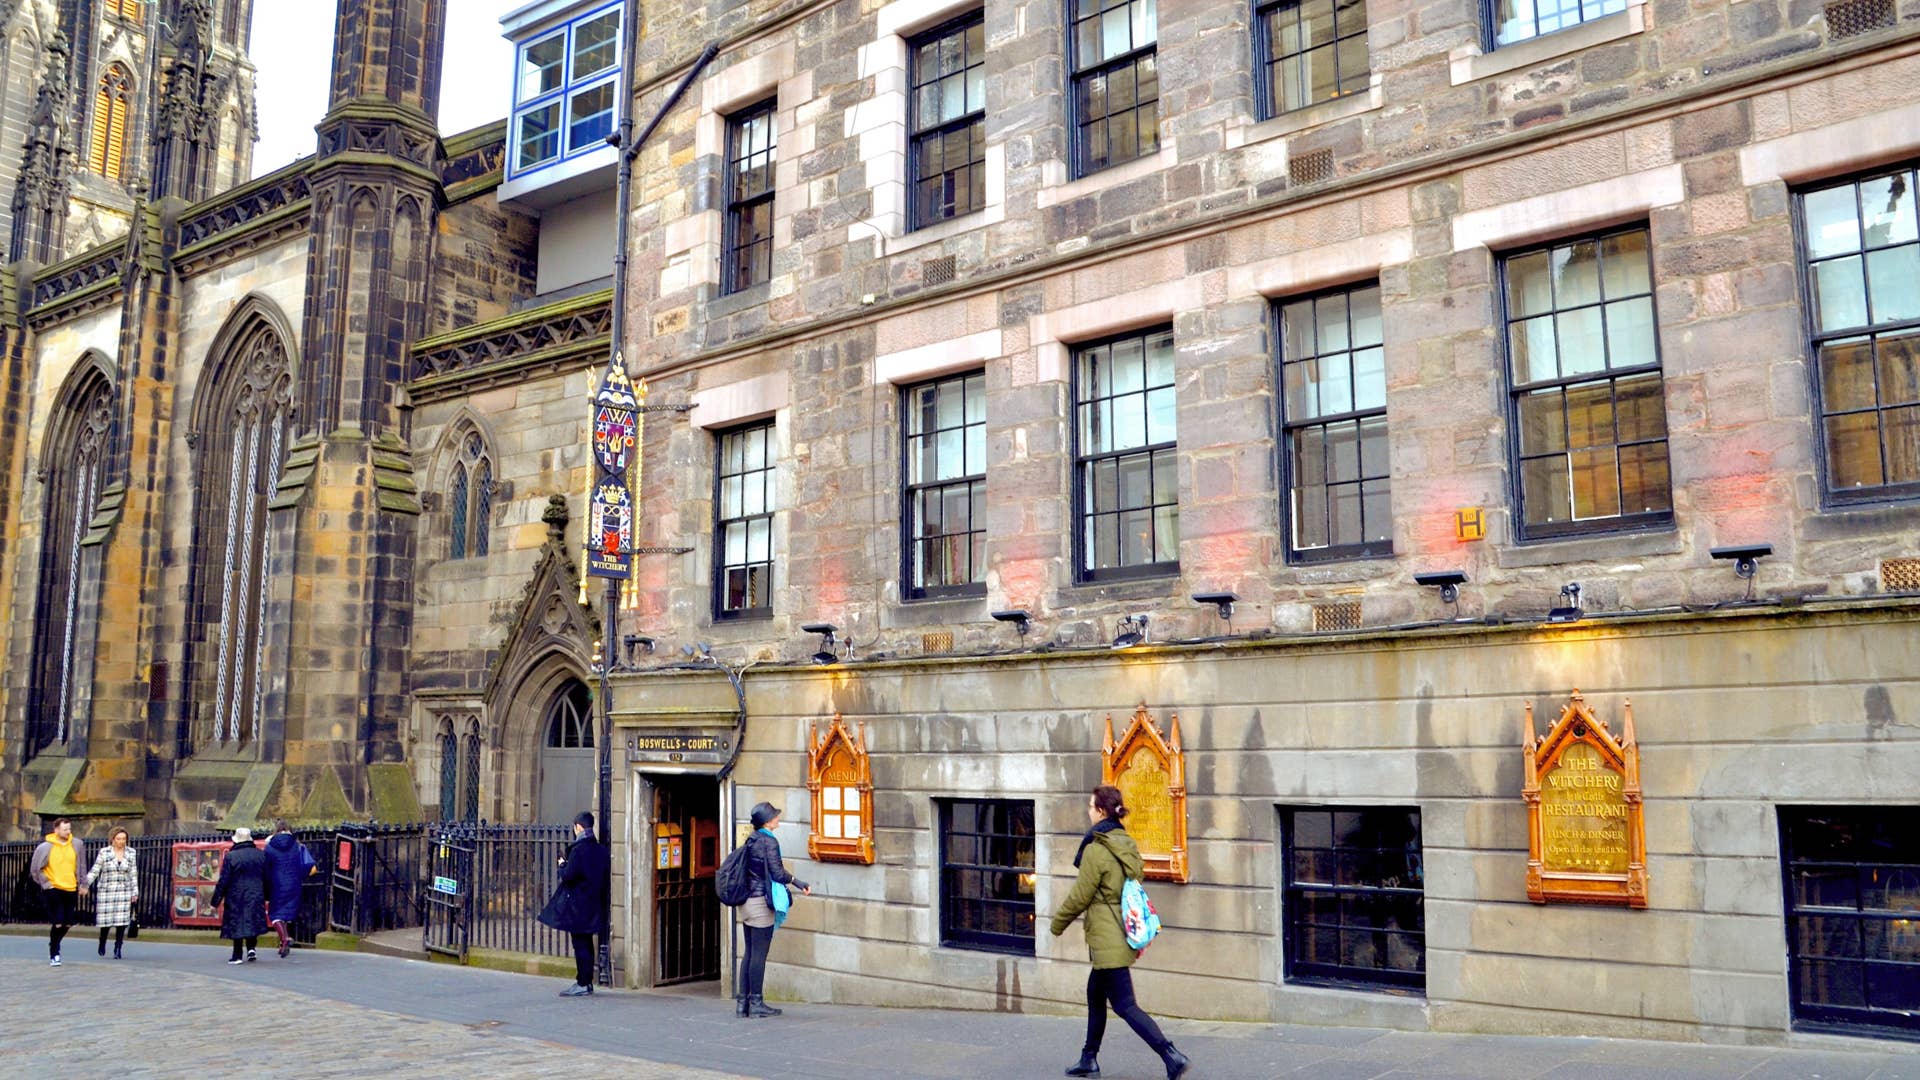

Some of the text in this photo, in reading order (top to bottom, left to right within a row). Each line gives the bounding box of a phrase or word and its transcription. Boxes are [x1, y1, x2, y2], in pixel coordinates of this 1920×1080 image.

[603, 554, 617, 562] THE
[591, 560, 628, 571] WITCHERY
[639, 738, 713, 749] BOSWELL'S COURT
[1568, 758, 1597, 770] THE
[828, 771, 857, 782] MENU
[1548, 775, 1620, 792] WITCHERY
[1545, 803, 1627, 820] RESTAURANT
[1547, 830, 1578, 840] LUNCH
[1588, 830, 1625, 841] DINNER
[1549, 845, 1570, 855] Open
[1580, 844, 1593, 856] day
